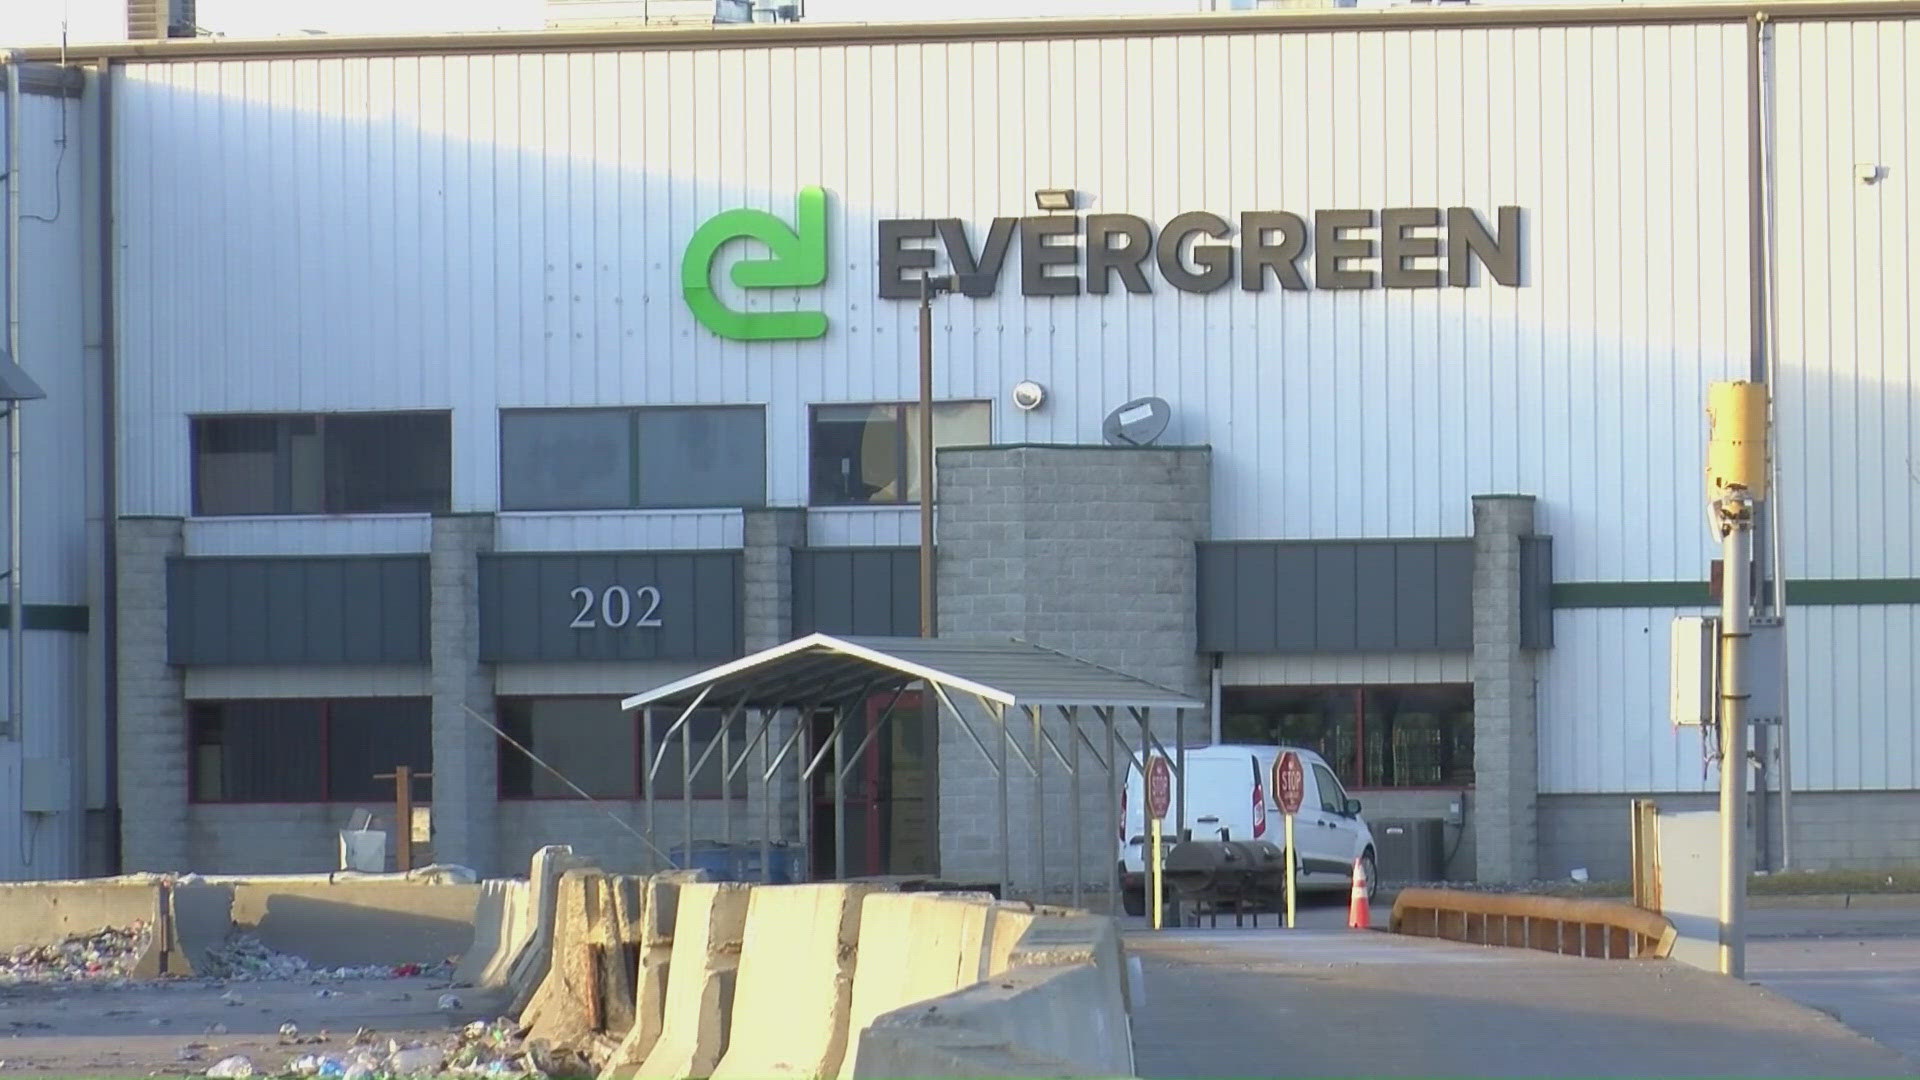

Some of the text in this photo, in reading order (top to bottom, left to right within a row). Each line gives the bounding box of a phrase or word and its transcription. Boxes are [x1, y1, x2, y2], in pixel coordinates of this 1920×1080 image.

[878, 206, 1521, 299] EVERGREEN
[569, 585, 662, 628] 202
[1282, 770, 1302, 791] STOP
